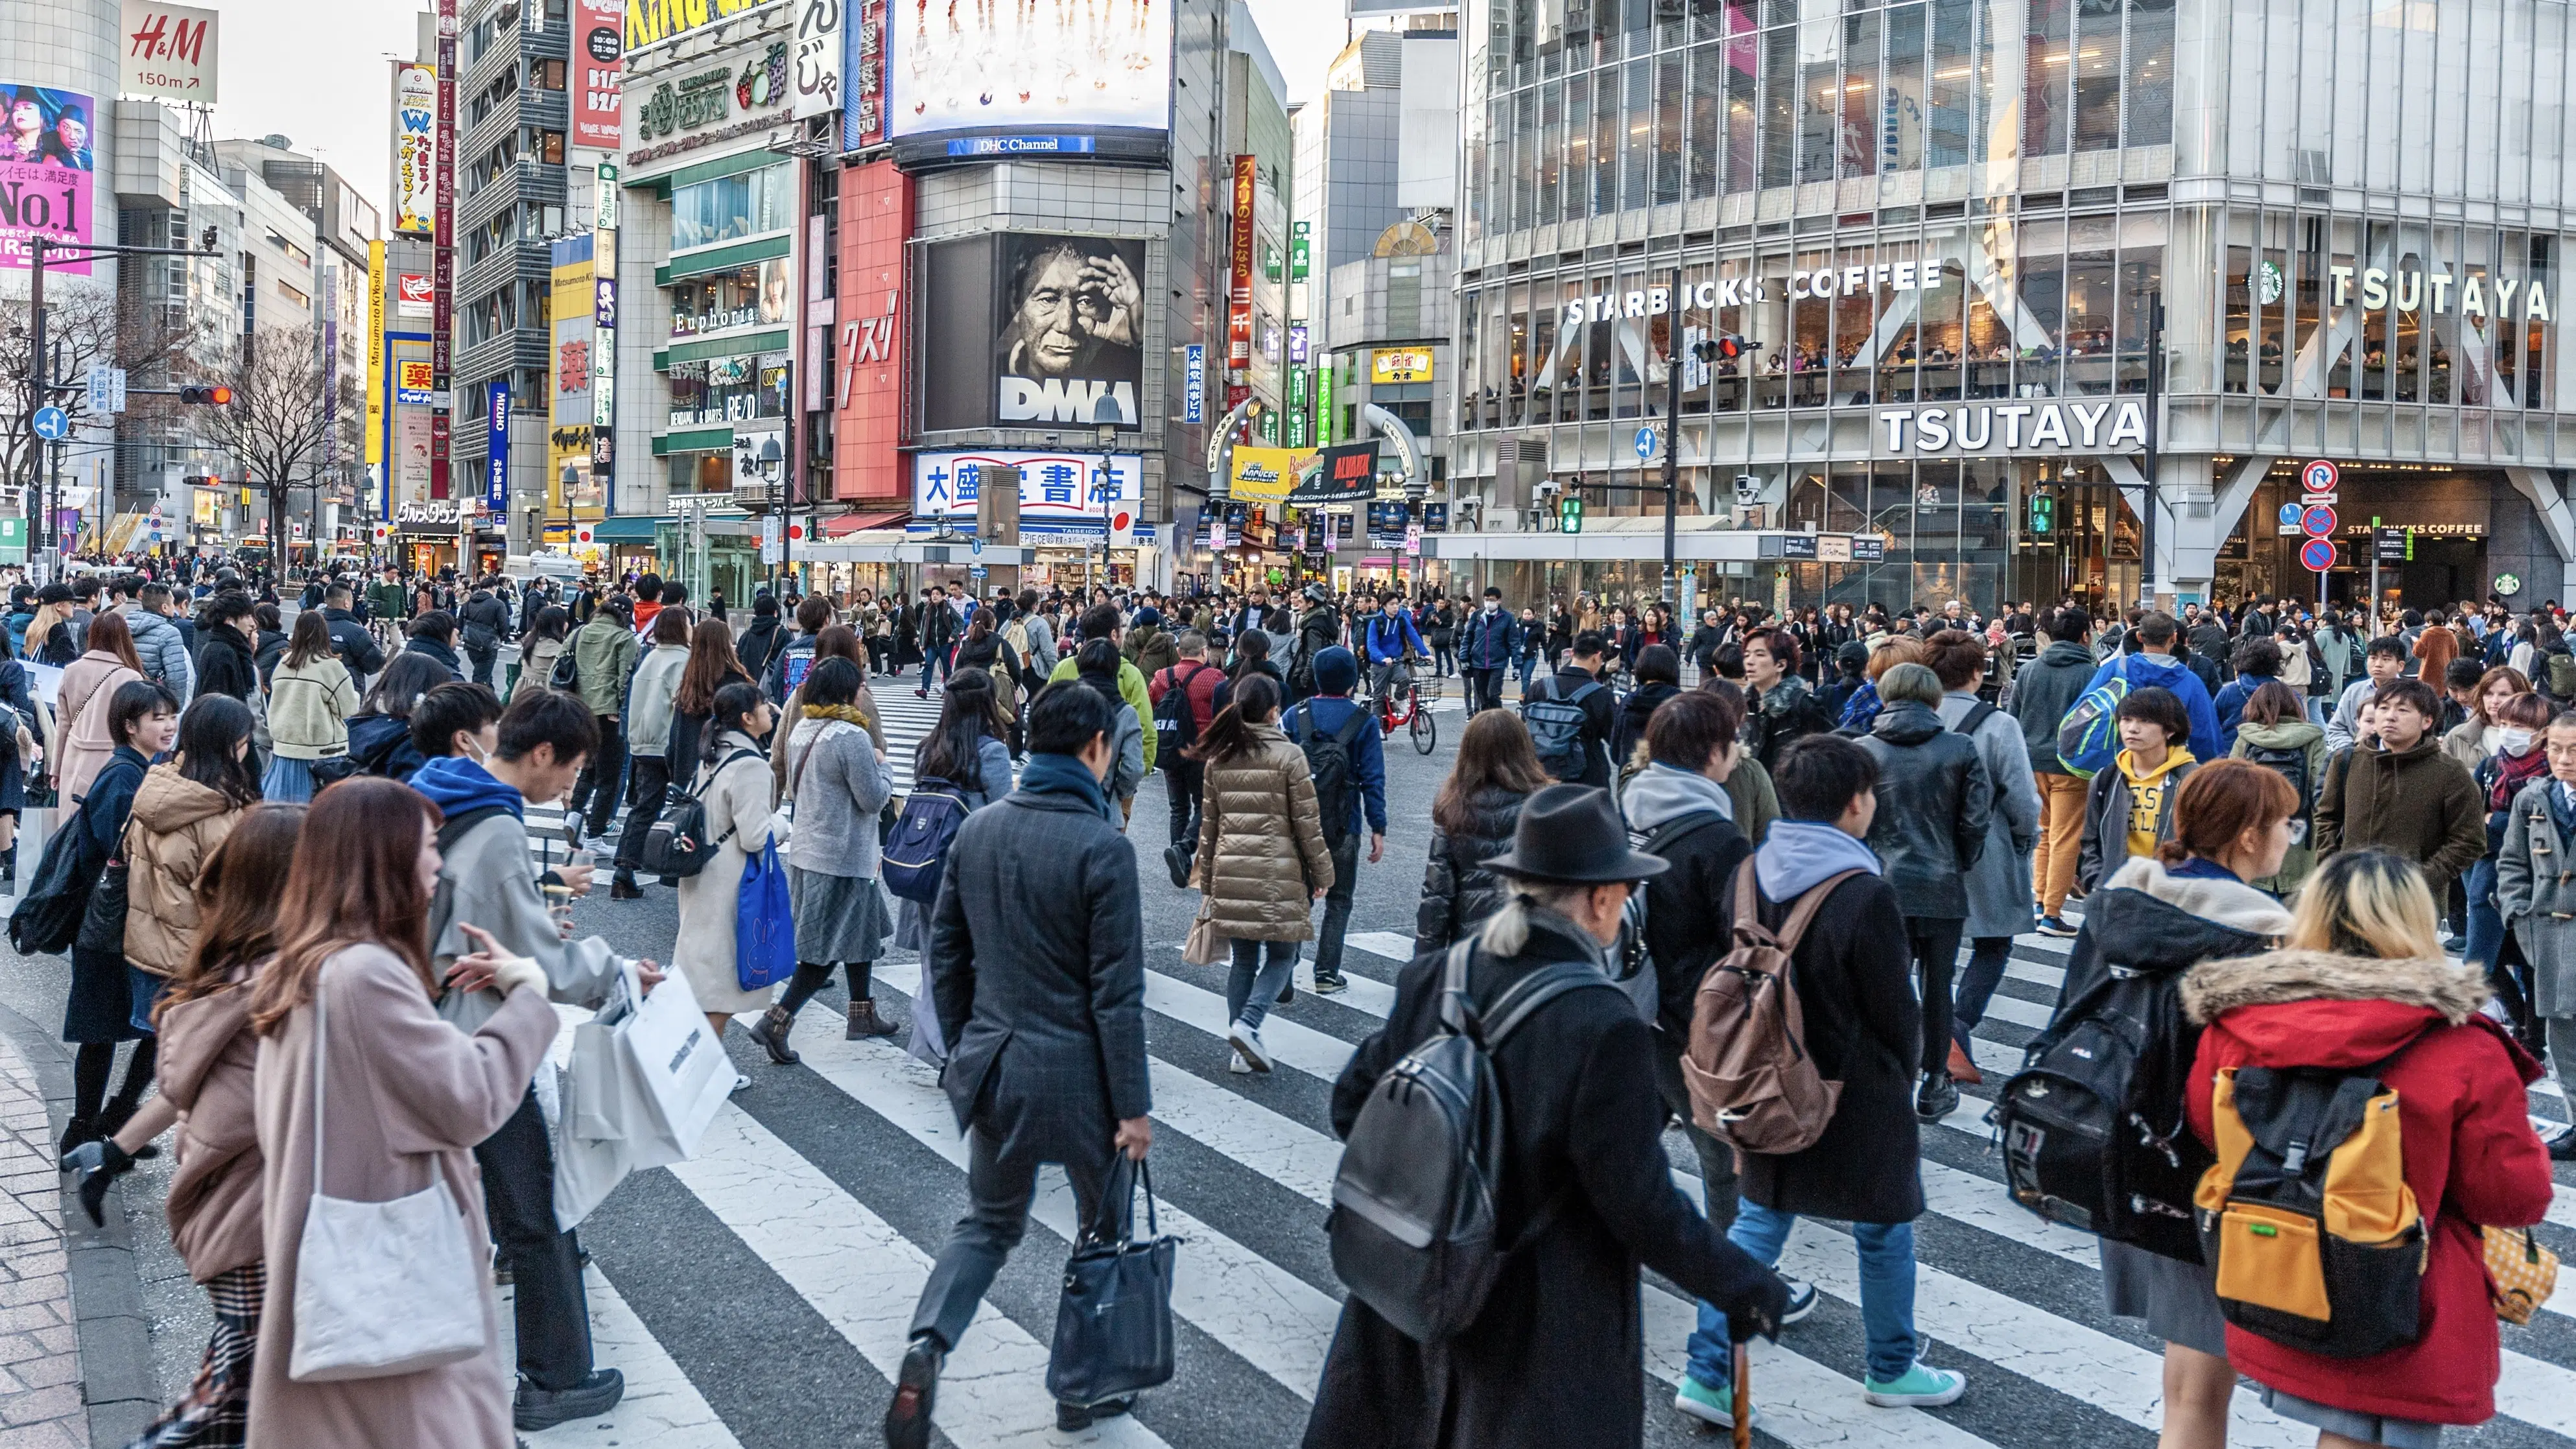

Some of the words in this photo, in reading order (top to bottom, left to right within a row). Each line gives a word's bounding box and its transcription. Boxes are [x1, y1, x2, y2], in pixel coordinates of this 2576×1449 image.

[131, 14, 207, 67] H&M
[587, 91, 620, 112] B2F
[980, 140, 1007, 151] DHC
[1009, 138, 1058, 150] Channel
[0, 181, 78, 233] No.1
[1236, 161, 1251, 277] クスリのことなら
[372, 269, 381, 308] KiYoshi
[554, 276, 585, 288] Matsumoto
[1788, 259, 1943, 300] COFFEE
[2330, 265, 2549, 321] TSUTAYA
[372, 310, 381, 367] Matsumoto
[676, 305, 755, 335] Euphoria
[1232, 287, 1250, 360] 三千里
[407, 364, 432, 388] 薬
[560, 340, 589, 392] 薬
[1188, 350, 1202, 420] 大盛堂商事ビル
[97, 368, 106, 410] 渋谷駅前
[727, 394, 755, 423] RE/D
[496, 392, 506, 432] MIZUHO
[1879, 401, 2147, 451] TSUTAYA
[493, 459, 502, 501] みずほ銀行
[926, 464, 1126, 504] 大盛書店
[399, 501, 460, 524] グルメタウン
[2348, 524, 2426, 534] STAKS
[2428, 524, 2483, 534] COFFEE
